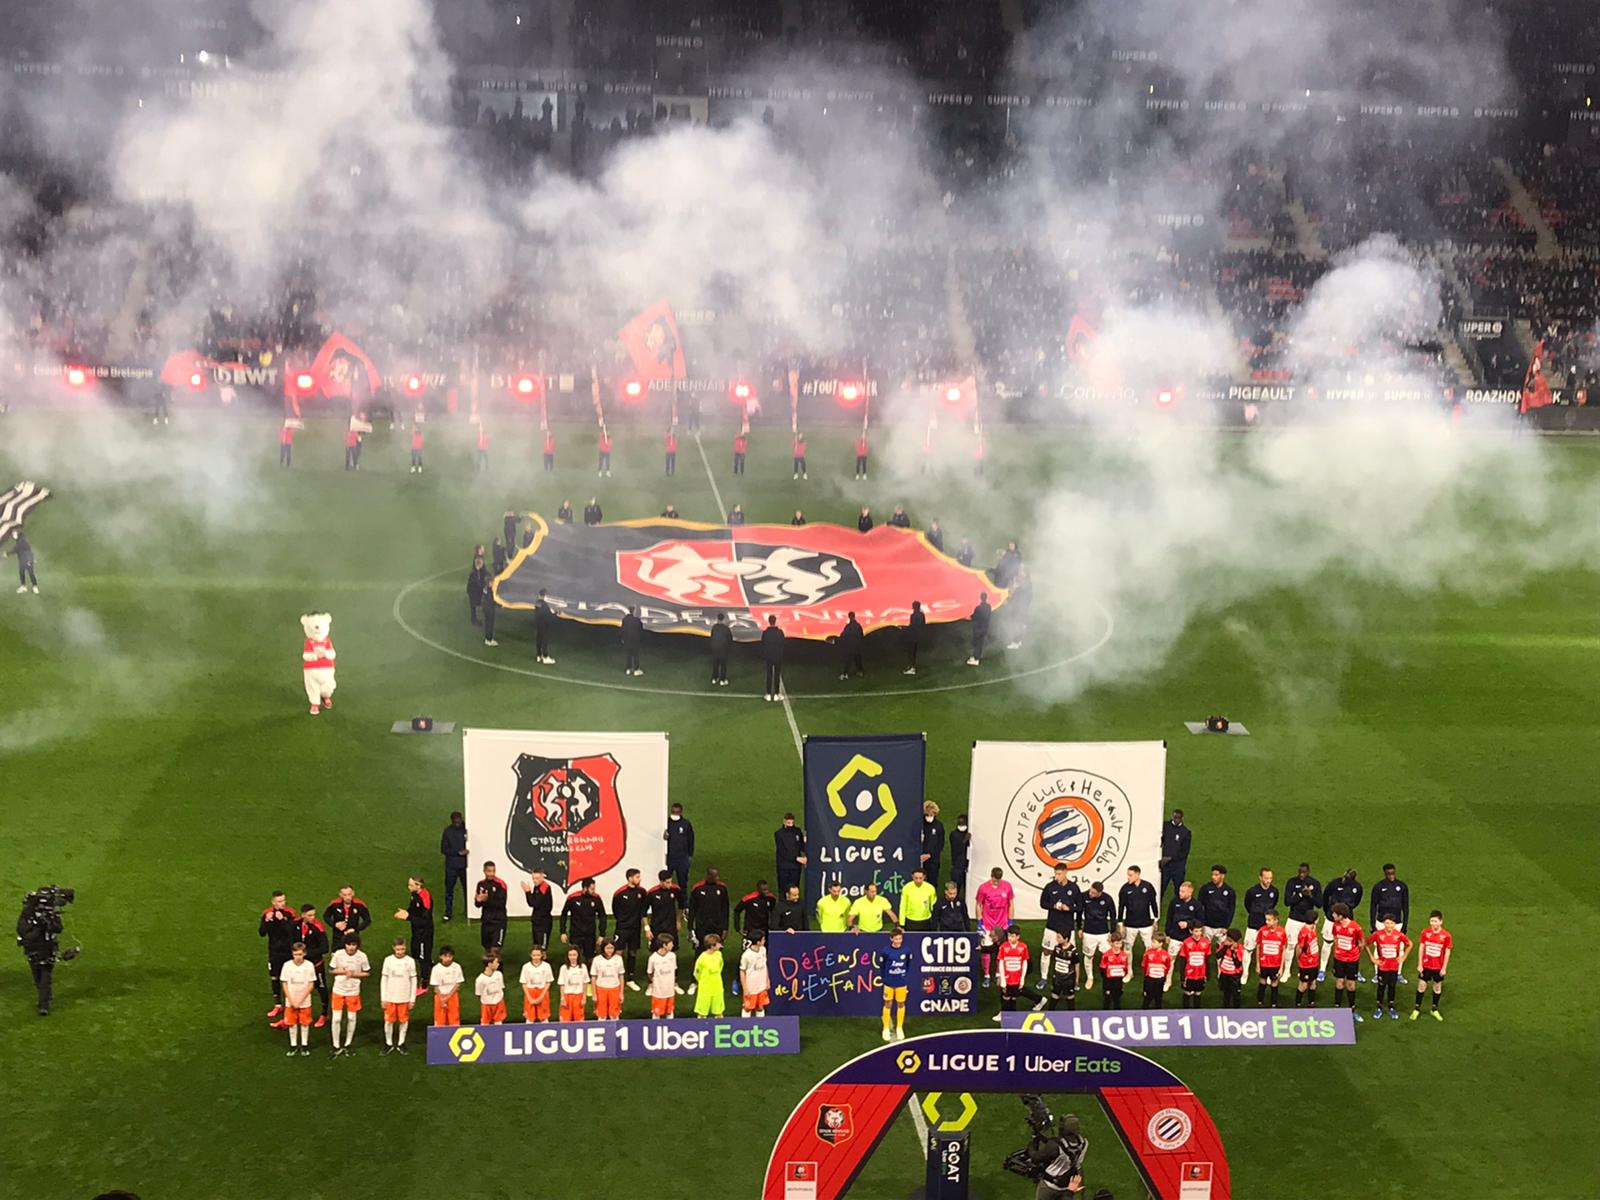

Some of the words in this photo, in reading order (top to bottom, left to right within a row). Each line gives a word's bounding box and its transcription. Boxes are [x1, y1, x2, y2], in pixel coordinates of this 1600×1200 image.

[656, 36, 691, 48] SUPER
[987, 95, 1020, 105] SUPER
[1146, 99, 1179, 110] HYPER
[1204, 100, 1236, 111] SUPER
[1360, 105, 1393, 115] HYPER
[1417, 106, 1450, 116] SUPER
[234, 368, 278, 385] BWT
[1229, 386, 1295, 401] PIGEAULT
[1326, 389, 1364, 401] HYPER
[820, 845, 886, 863] LIGUE
[893, 846, 904, 861] 1
[933, 937, 971, 963] 119
[775, 984, 789, 996] de
[920, 999, 970, 1012] CNAPE
[1072, 1016, 1171, 1041] LIGUE
[1177, 1015, 1192, 1039] 1
[1204, 1015, 1266, 1039] Uber
[1271, 1015, 1336, 1038] Eats
[505, 1026, 606, 1056] LIGUE
[616, 1026, 629, 1051] 1
[643, 1025, 709, 1050] Uber
[714, 1024, 780, 1049] Eats
[928, 1054, 999, 1071] LIGUE
[1006, 1054, 1016, 1071] 1
[1025, 1055, 1072, 1072] Uber
[1075, 1056, 1121, 1072] Eats
[947, 1141, 961, 1183] GOAT
